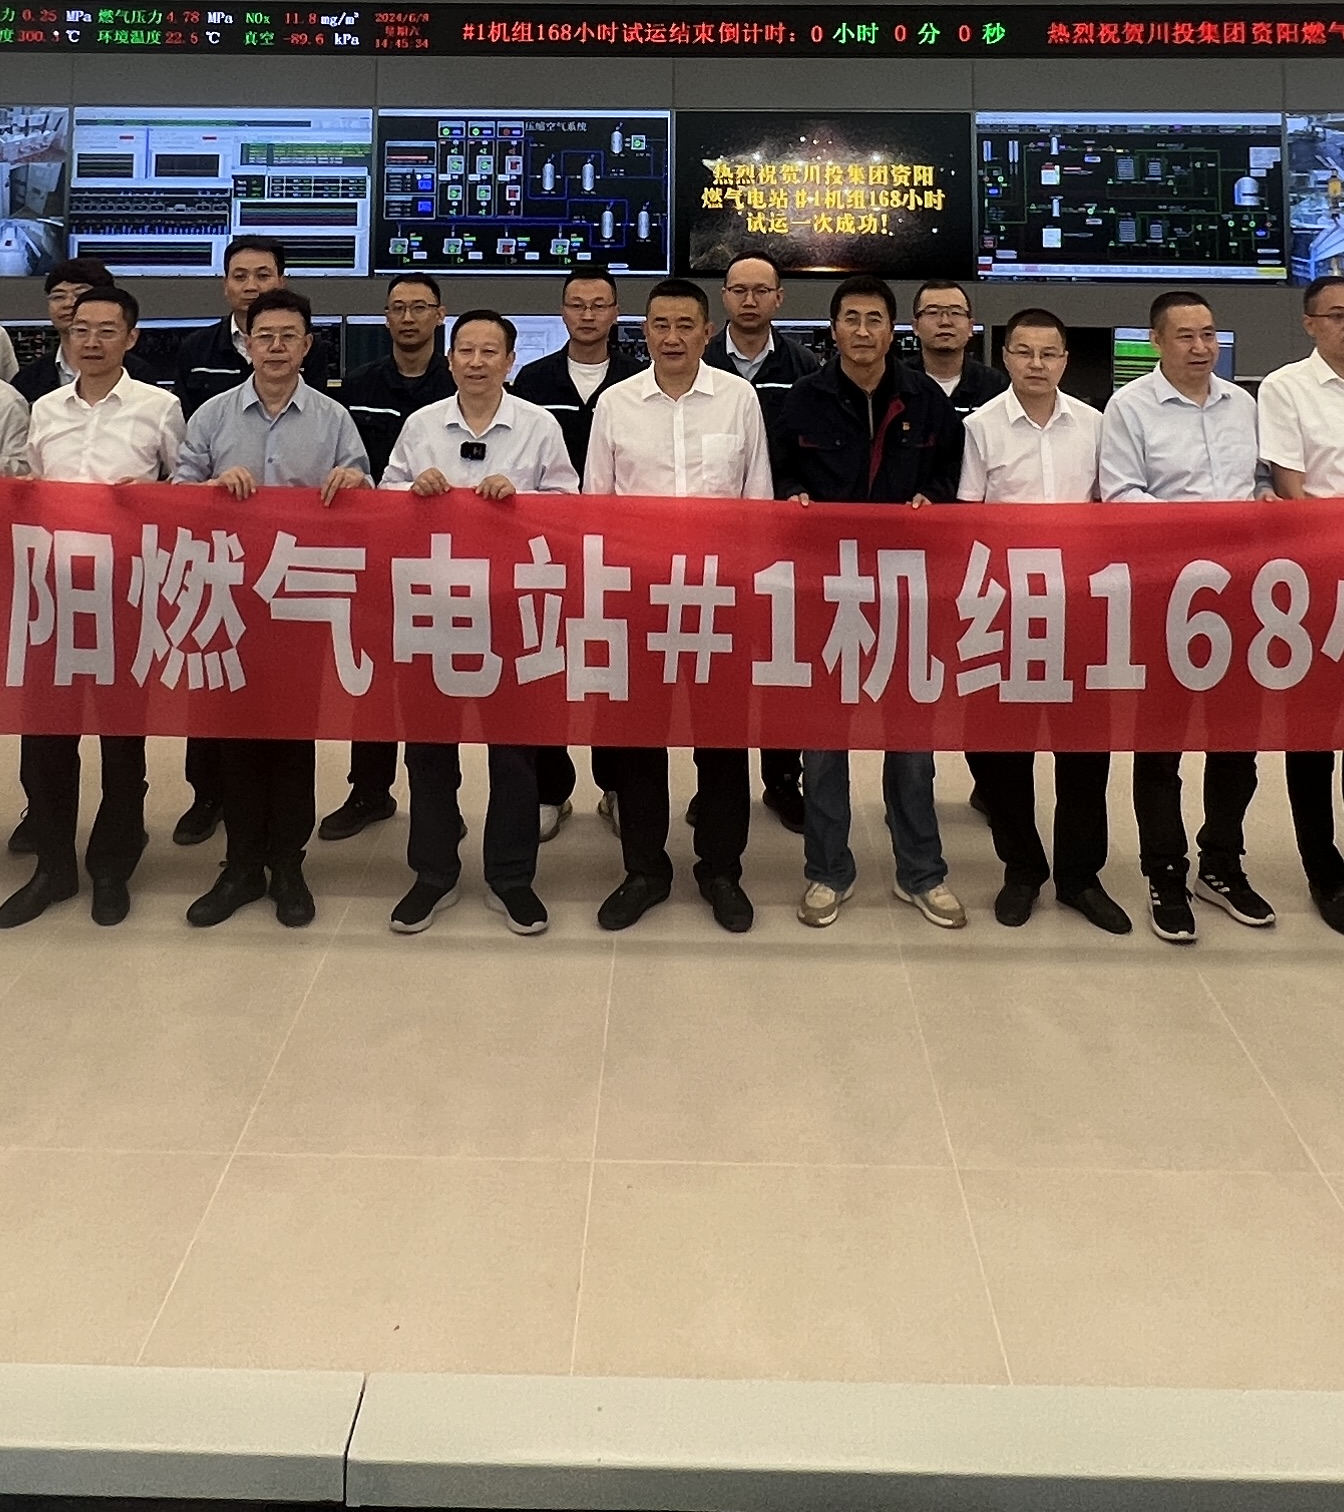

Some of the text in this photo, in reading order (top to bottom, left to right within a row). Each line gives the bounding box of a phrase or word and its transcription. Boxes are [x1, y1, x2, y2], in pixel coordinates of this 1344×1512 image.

[66, 9, 92, 23] MPa
[98, 9, 163, 24] 燃气压力
[207, 11, 233, 24] MPa
[97, 29, 162, 45] 环境温度
[244, 31, 275, 46] 真空
[334, 32, 360, 46] kPa
[811, 25, 823, 42] 0
[833, 22, 879, 44] 小时
[894, 24, 907, 42] 0
[917, 22, 941, 44] 分
[958, 24, 971, 42] 0
[981, 22, 1006, 45] 秒
[713, 164, 935, 186] 热烈祝贺川投集团资阳
